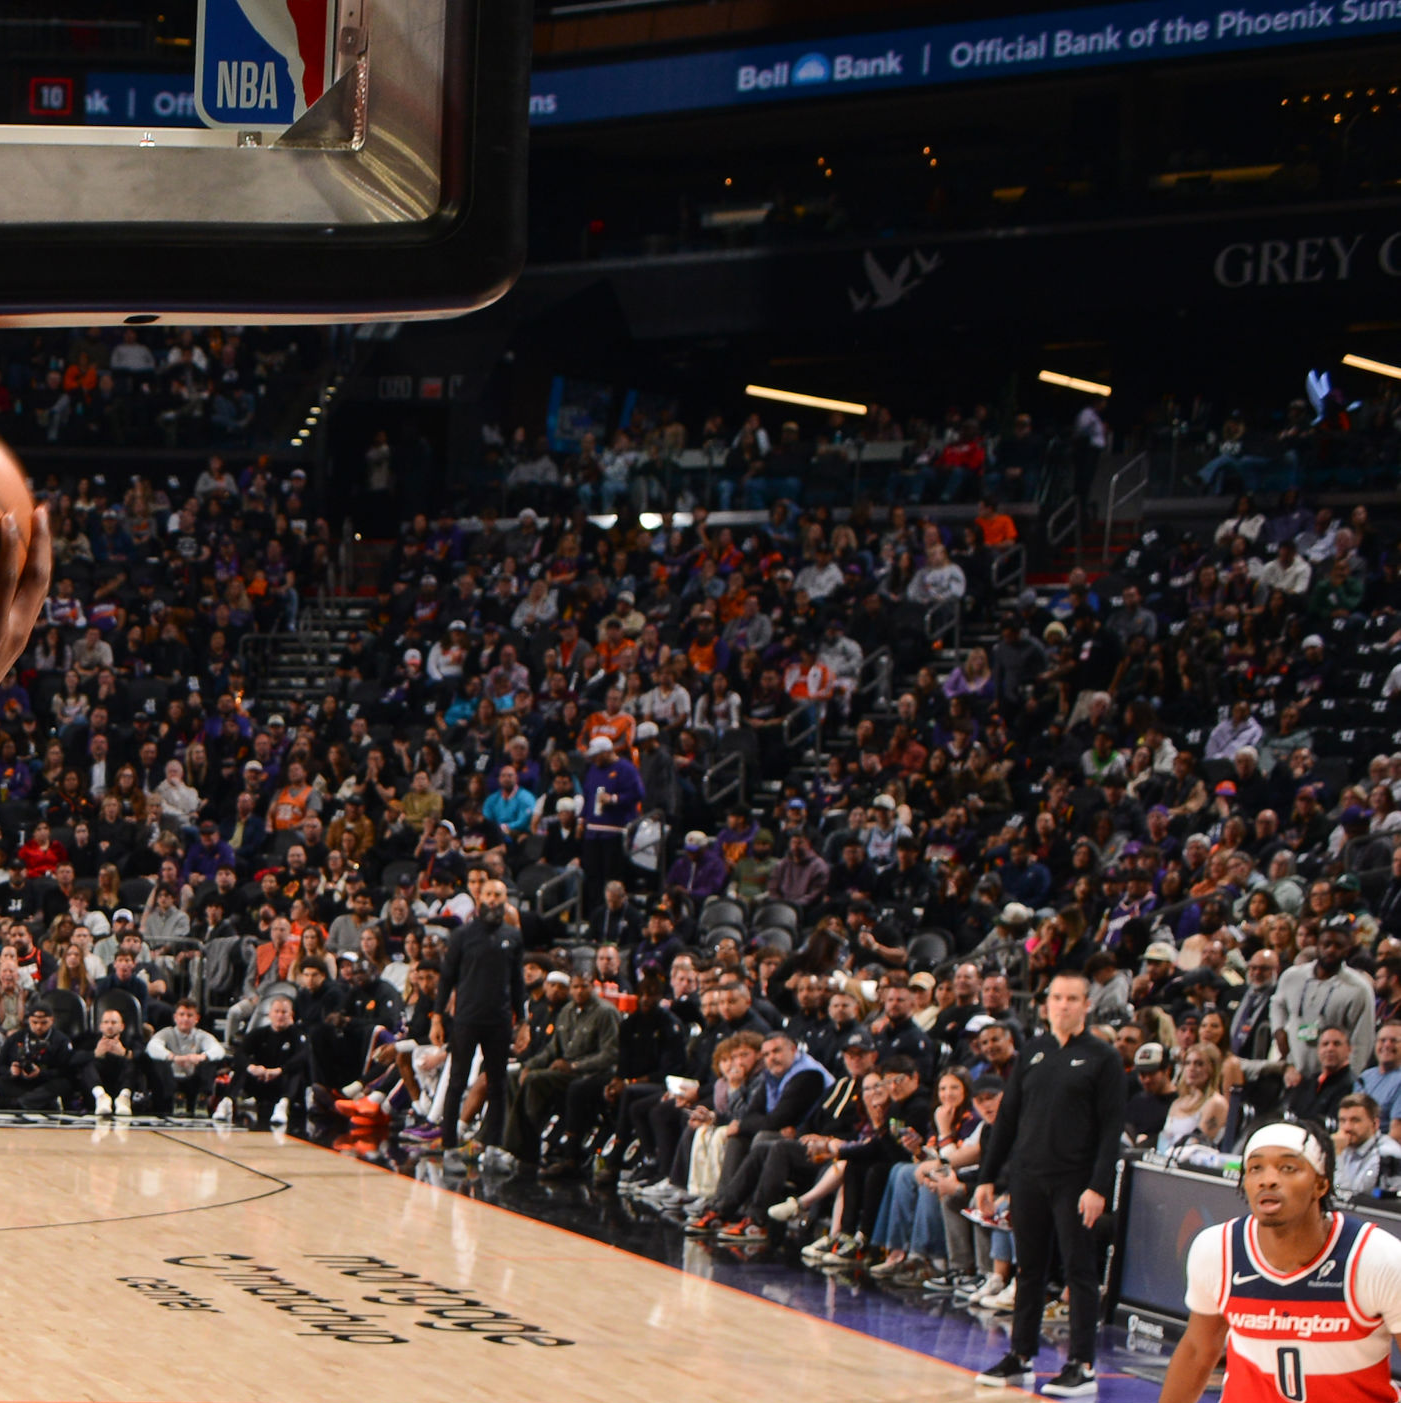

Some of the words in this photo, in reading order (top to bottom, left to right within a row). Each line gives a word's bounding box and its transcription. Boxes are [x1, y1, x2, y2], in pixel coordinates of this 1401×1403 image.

[737, 61, 791, 92] Bell
[832, 49, 905, 82] Bank
[949, 32, 1047, 68] Official
[1053, 25, 1121, 58] Bank
[1127, 18, 1159, 49] of
[1164, 16, 1211, 45] the
[1217, 2, 1334, 39] Phoenix
[40, 85, 65, 109] 10
[216, 60, 279, 110] NBA
[529, 92, 558, 116] ns
[1213, 233, 1366, 288] GREY
[214, 1273, 410, 1345] matchup
[303, 1254, 577, 1347] mortgage
[1227, 1307, 1351, 1338] washington
